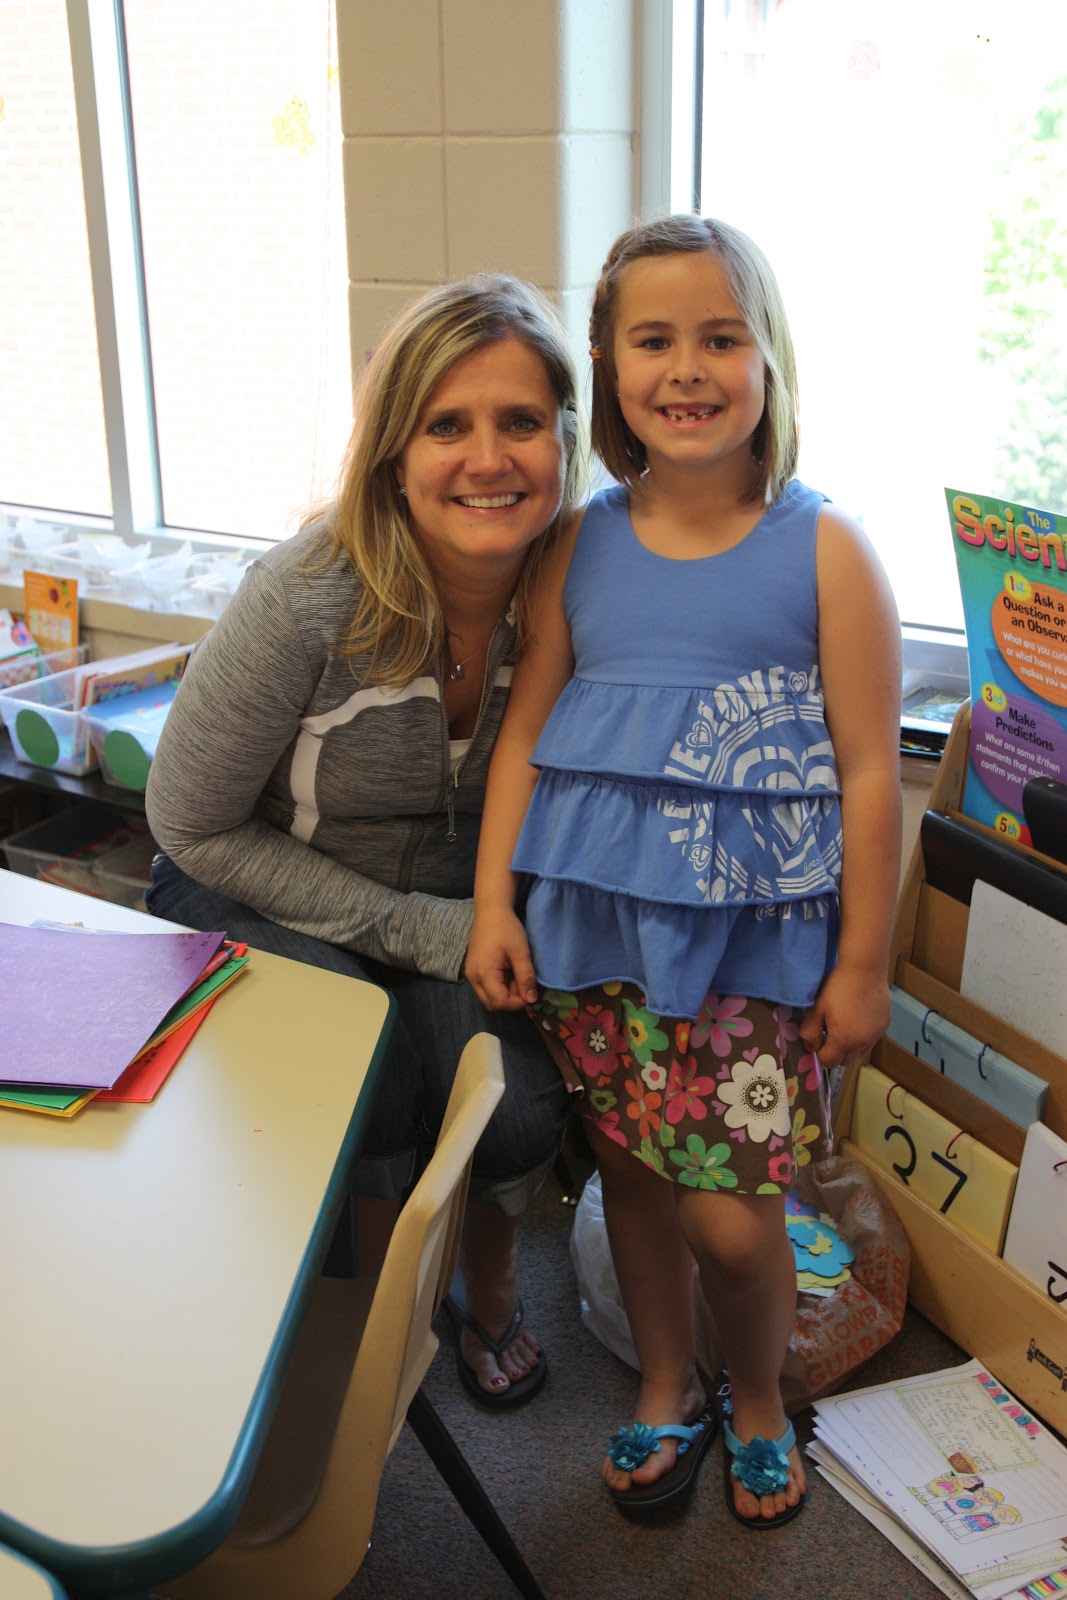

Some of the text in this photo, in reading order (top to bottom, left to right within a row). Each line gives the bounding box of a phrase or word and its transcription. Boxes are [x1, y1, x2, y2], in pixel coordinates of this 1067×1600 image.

[1027, 511, 1050, 529] The
[1010, 575, 1025, 592] 1st
[1003, 596, 1066, 627] Question or
[1034, 592, 1065, 612] Ask a
[1011, 617, 1025, 628] an
[1003, 632, 1022, 646] What
[1023, 640, 1036, 650] are
[1037, 645, 1051, 656] you
[1006, 648, 1014, 656] or
[1015, 650, 1033, 663] what
[1034, 656, 1052, 671] have
[1021, 666, 1044, 681] makes
[1045, 676, 1059, 687] you
[697, 665, 786, 737] LOVE
[986, 687, 1003, 706] 3rd
[1009, 708, 1036, 729] Make
[996, 716, 1055, 752] Predictions
[976, 744, 1013, 766] statements
[1013, 760, 1027, 773] that
[985, 732, 1061, 773] What are some if/then
[981, 760, 1006, 777] confirm
[1007, 772, 1022, 785] your
[1000, 817, 1018, 838] 5th
[972, 1372, 1010, 1405] DEAR
